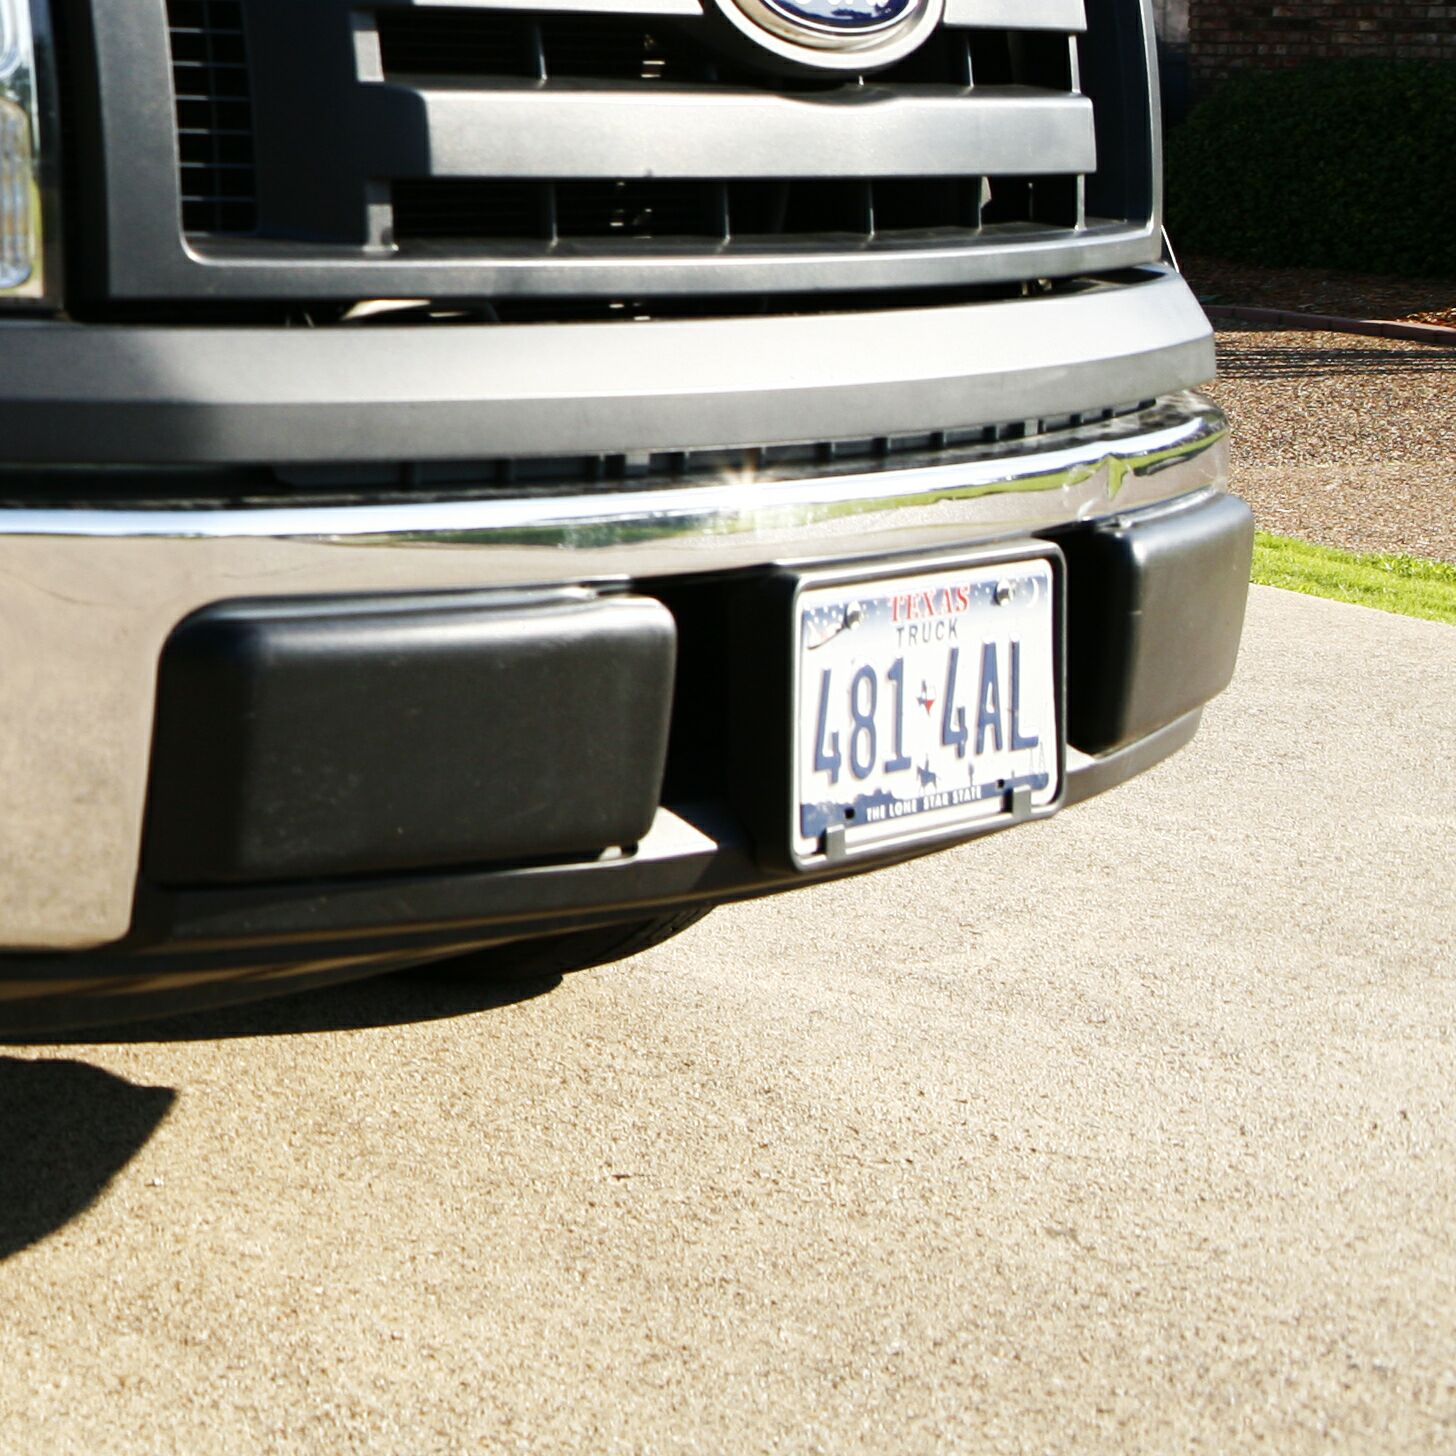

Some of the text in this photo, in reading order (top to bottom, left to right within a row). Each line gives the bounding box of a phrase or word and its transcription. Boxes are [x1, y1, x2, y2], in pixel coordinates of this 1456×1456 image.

[890, 586, 970, 621] TEXAS
[896, 617, 958, 648] TRUCK
[814, 639, 1039, 785] 481 4AL
[866, 784, 982, 822] THE LONE STAR STATE
